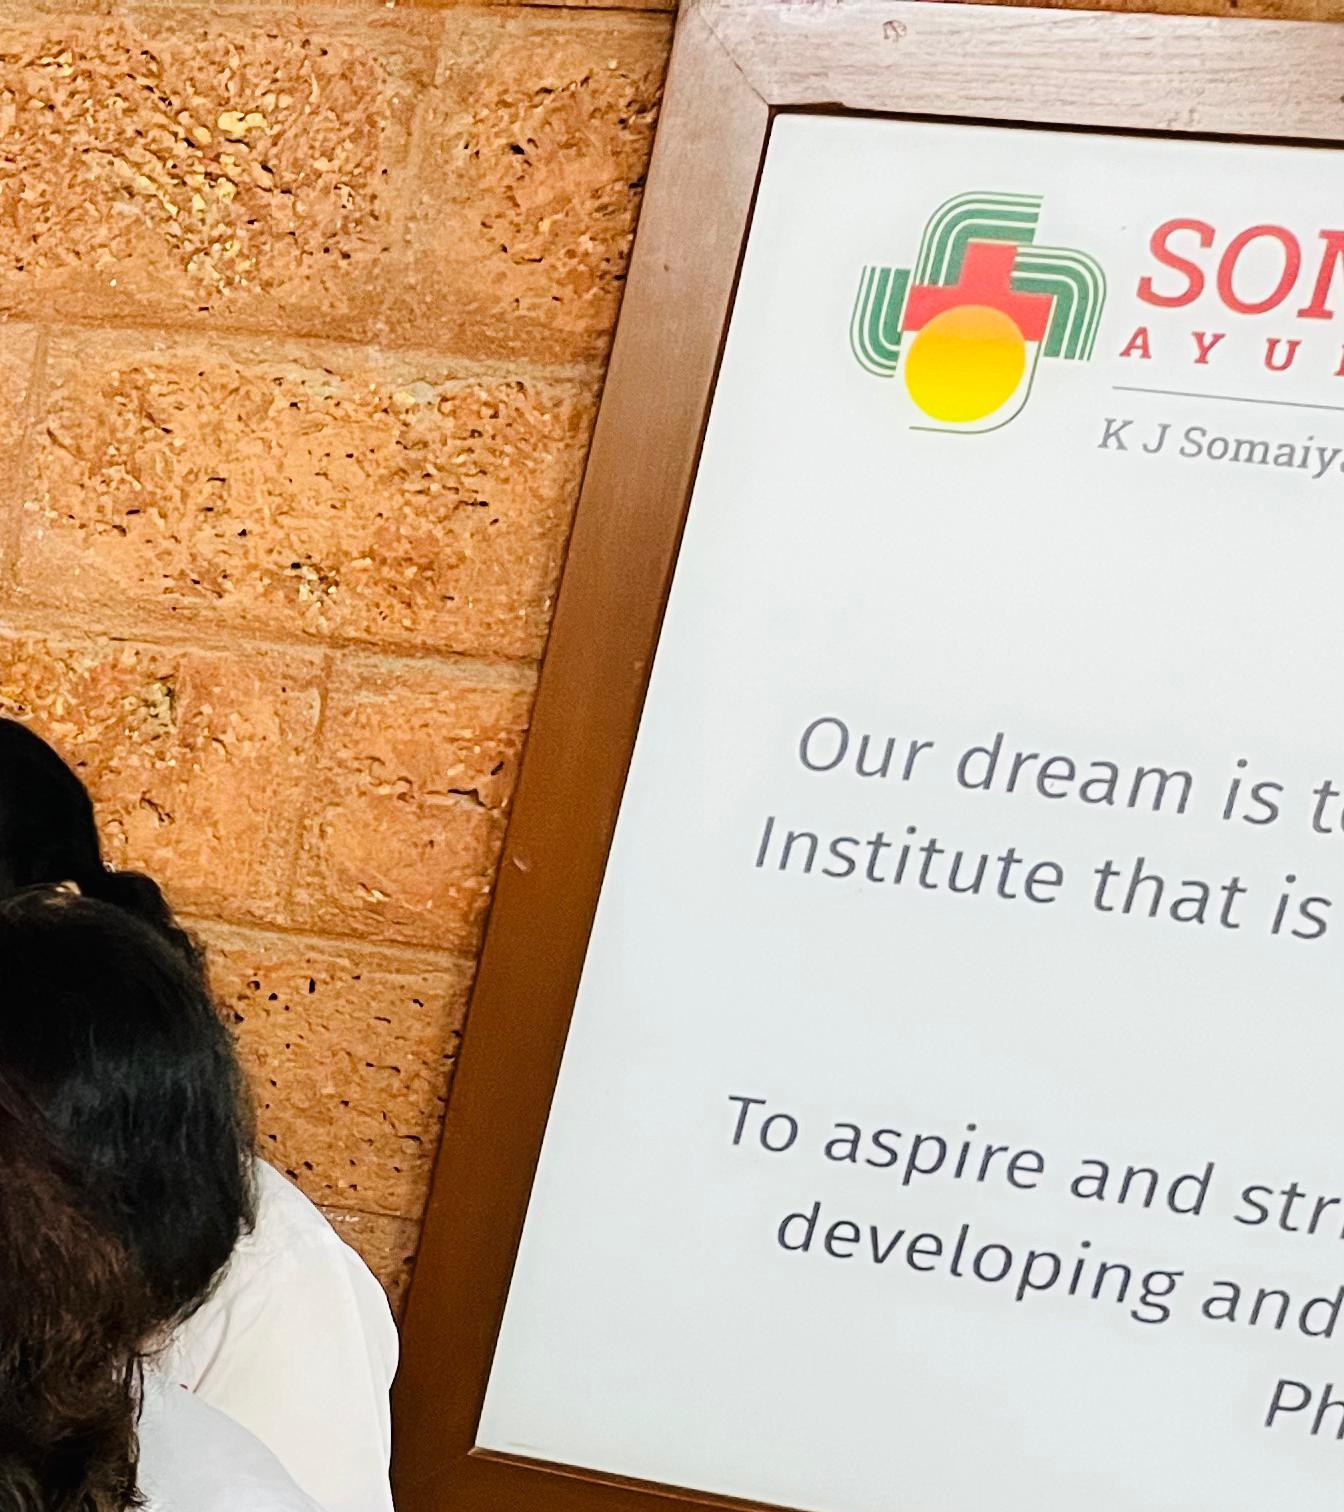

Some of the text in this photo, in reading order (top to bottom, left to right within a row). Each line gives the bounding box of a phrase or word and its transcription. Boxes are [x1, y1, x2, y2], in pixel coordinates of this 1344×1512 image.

[1118, 325, 1344, 378] AYU
[1097, 417, 1344, 480] K J Somaiy
[799, 716, 1344, 834] Our dream is t
[755, 815, 1333, 941] Institute that is
[728, 1094, 1344, 1240] To aspire and str
[777, 1201, 1344, 1339] developing and
